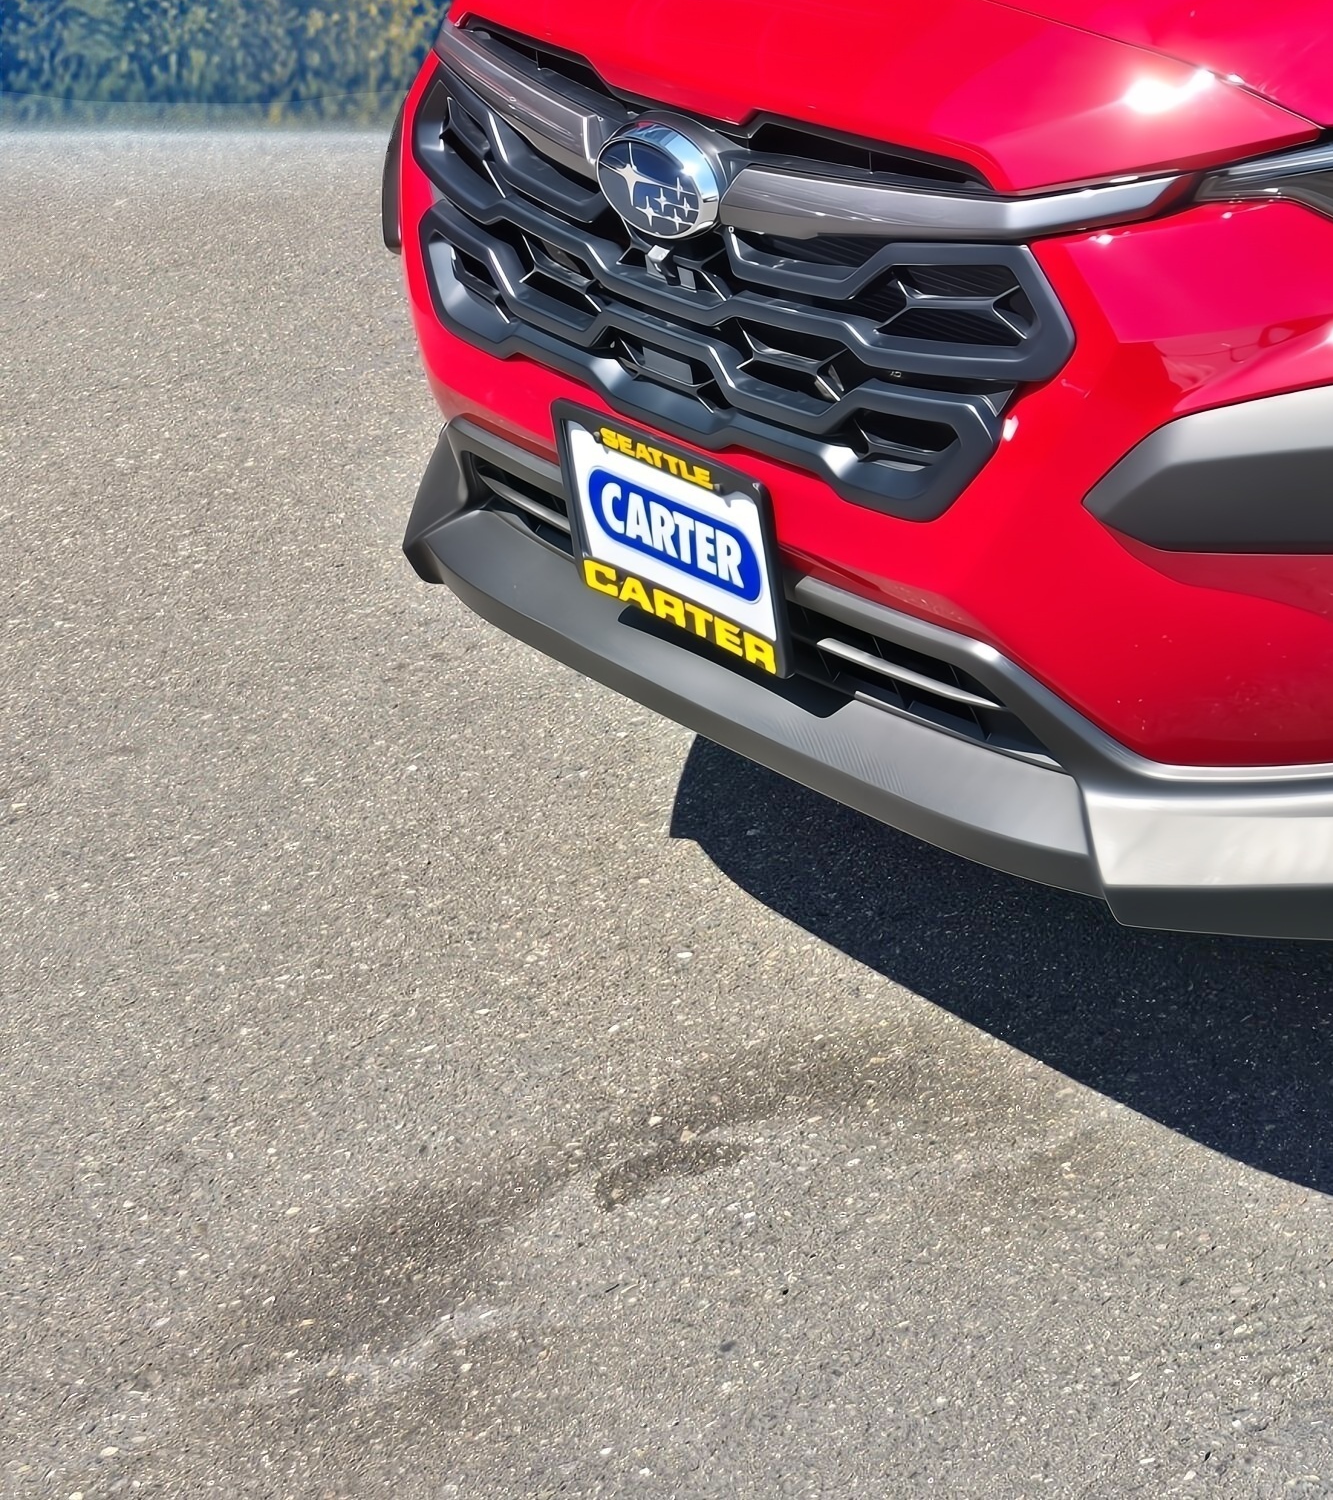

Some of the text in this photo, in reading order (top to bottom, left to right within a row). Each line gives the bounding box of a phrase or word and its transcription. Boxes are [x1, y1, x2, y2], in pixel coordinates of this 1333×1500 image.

[599, 426, 714, 491] SEATTLE
[600, 481, 746, 590] CARTER
[583, 558, 778, 675] CARTER
